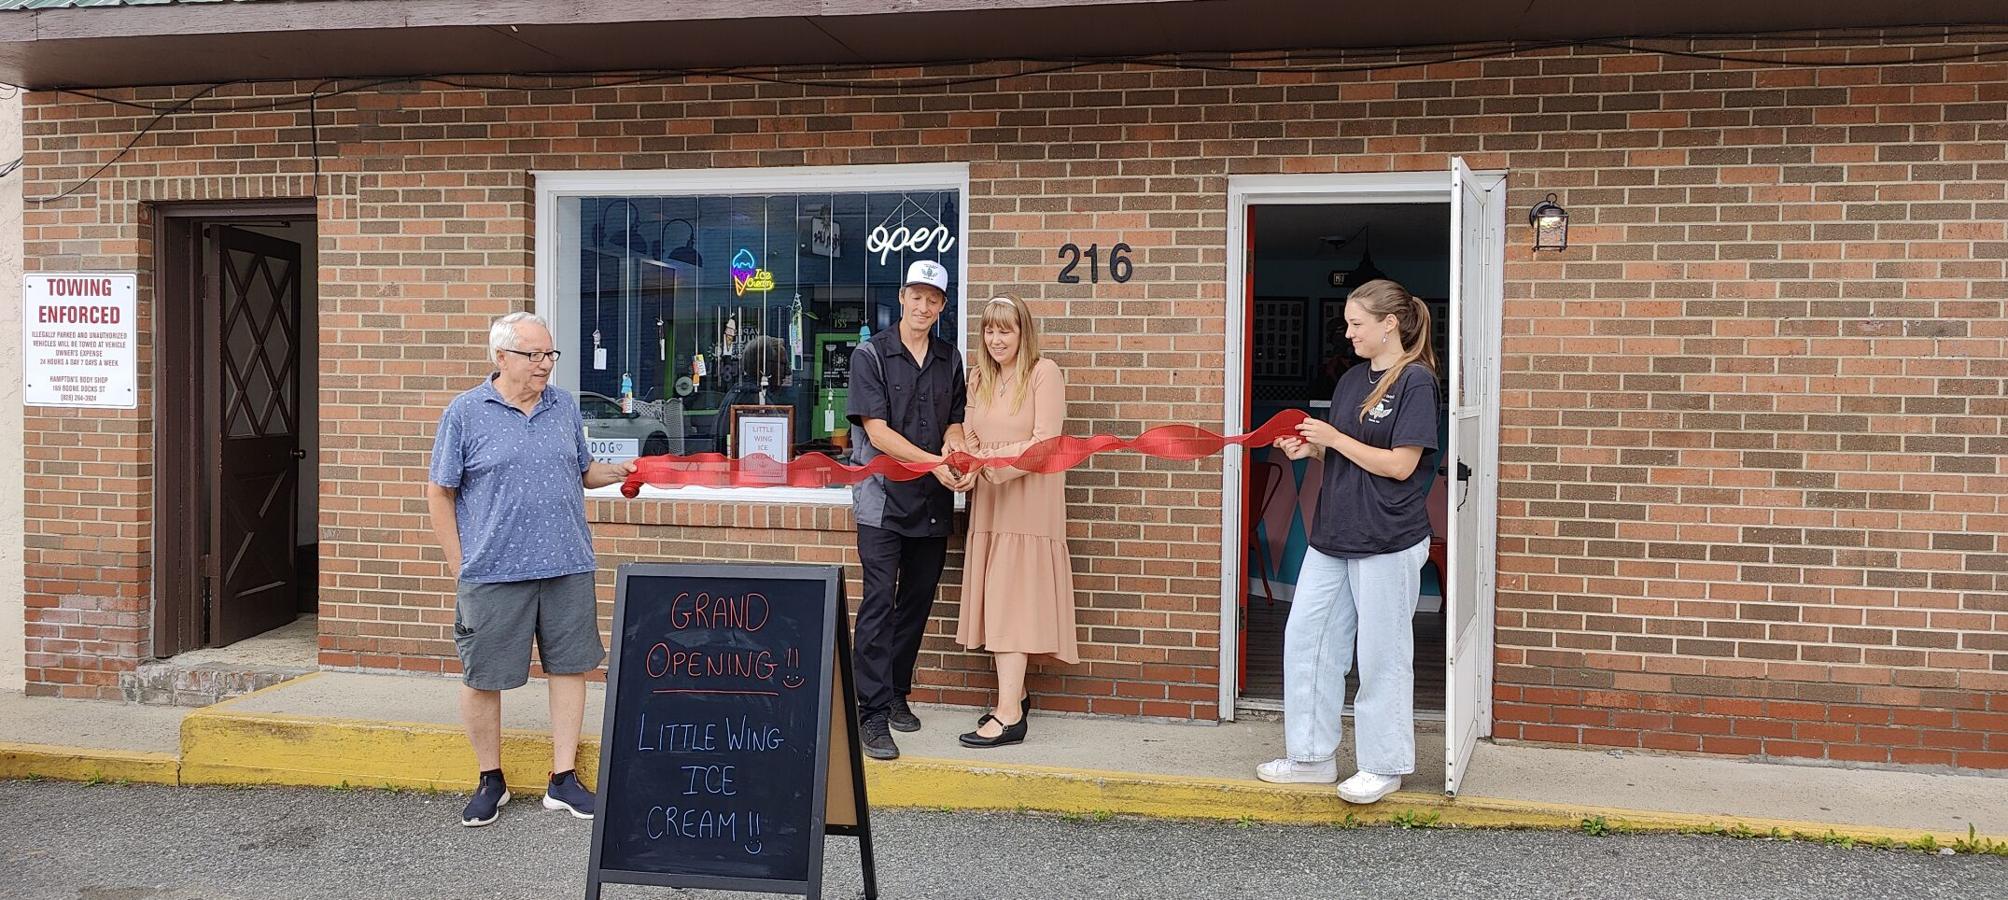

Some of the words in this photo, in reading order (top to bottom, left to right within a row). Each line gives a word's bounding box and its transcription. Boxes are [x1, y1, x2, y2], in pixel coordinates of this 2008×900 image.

[867, 226, 955, 265] open
[754, 268, 772, 280] Ice
[1058, 243, 1132, 283] 216
[47, 279, 111, 296] TOWING
[39, 306, 120, 324] ENFORCED
[94, 376, 108, 384] SHOP
[591, 442, 615, 453] DOG
[671, 592, 769, 632] GRAND
[638, 713, 716, 751] LITTLE
[725, 714, 784, 752] WING
[681, 765, 737, 796] ICE
